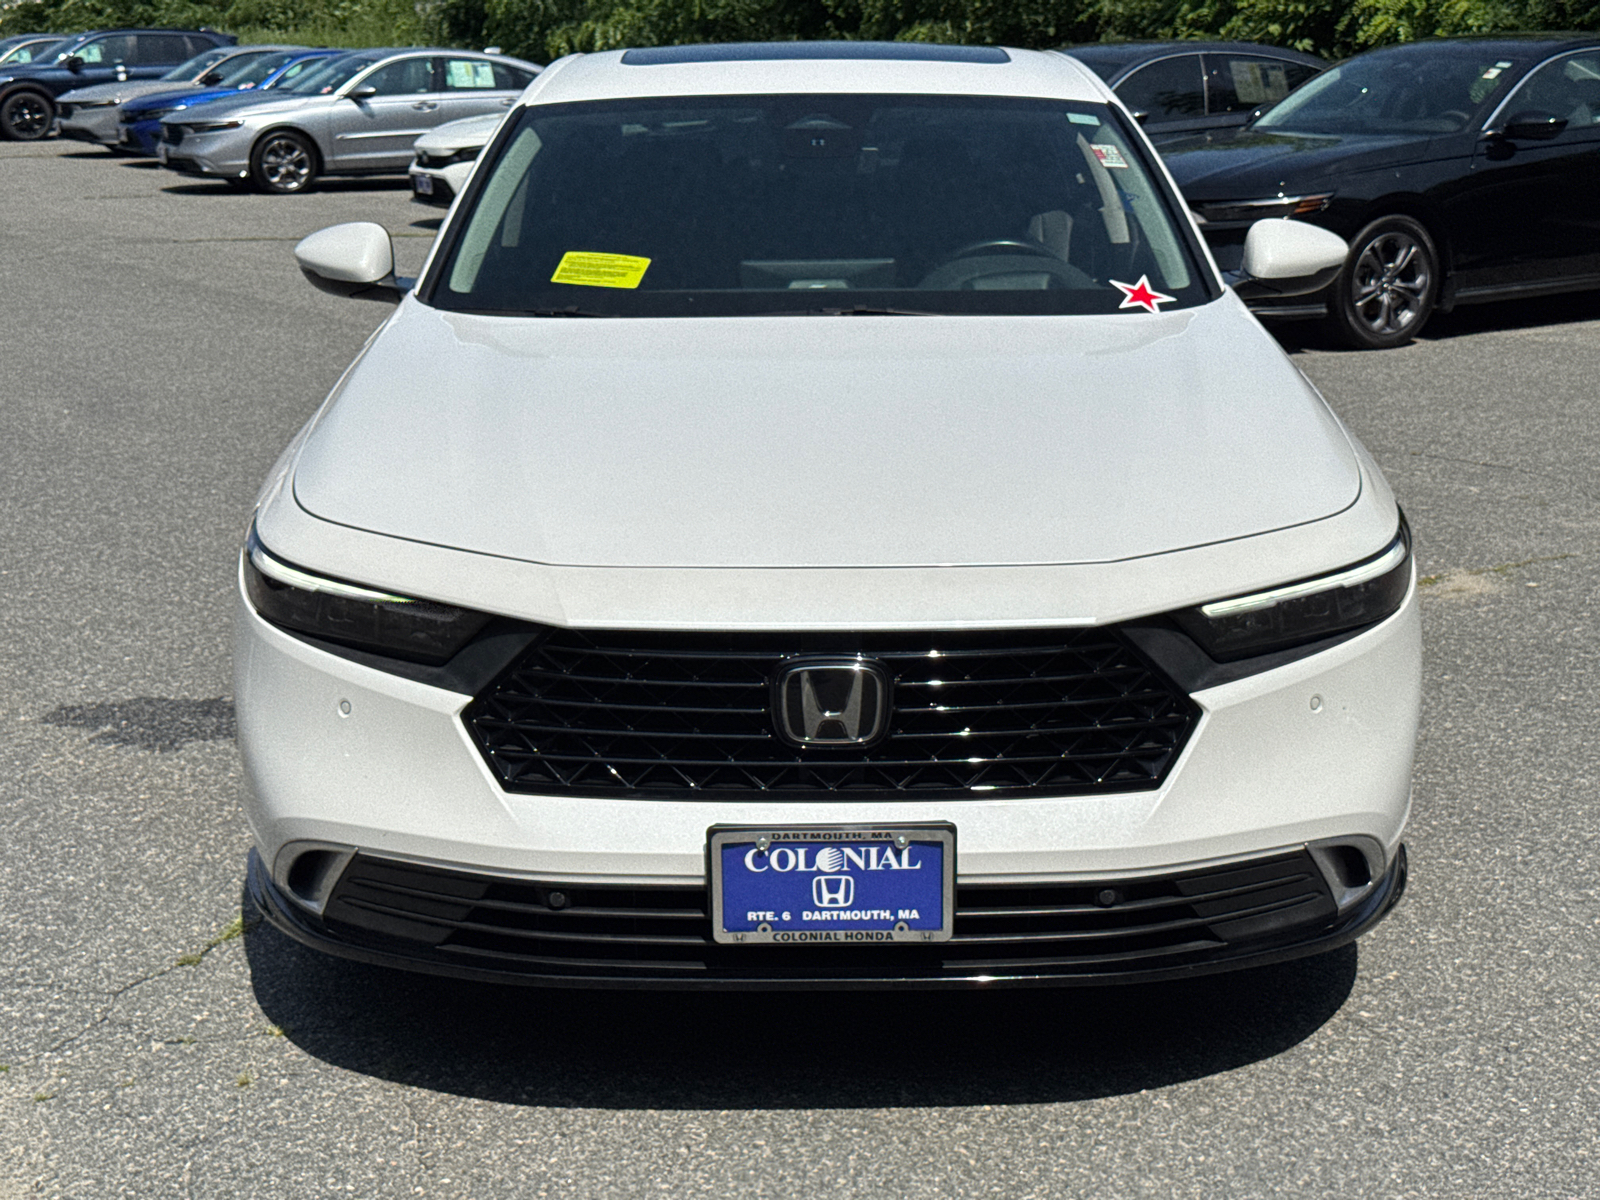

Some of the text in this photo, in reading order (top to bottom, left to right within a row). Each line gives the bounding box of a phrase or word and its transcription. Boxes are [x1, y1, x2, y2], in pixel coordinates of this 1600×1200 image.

[771, 832, 892, 841] DARTMOUTH, MA
[744, 846, 922, 873] COLONIAL
[747, 909, 920, 922] RTE. 6 DARTMOUTH, MA
[773, 931, 894, 942] COLONIAL HONDA
